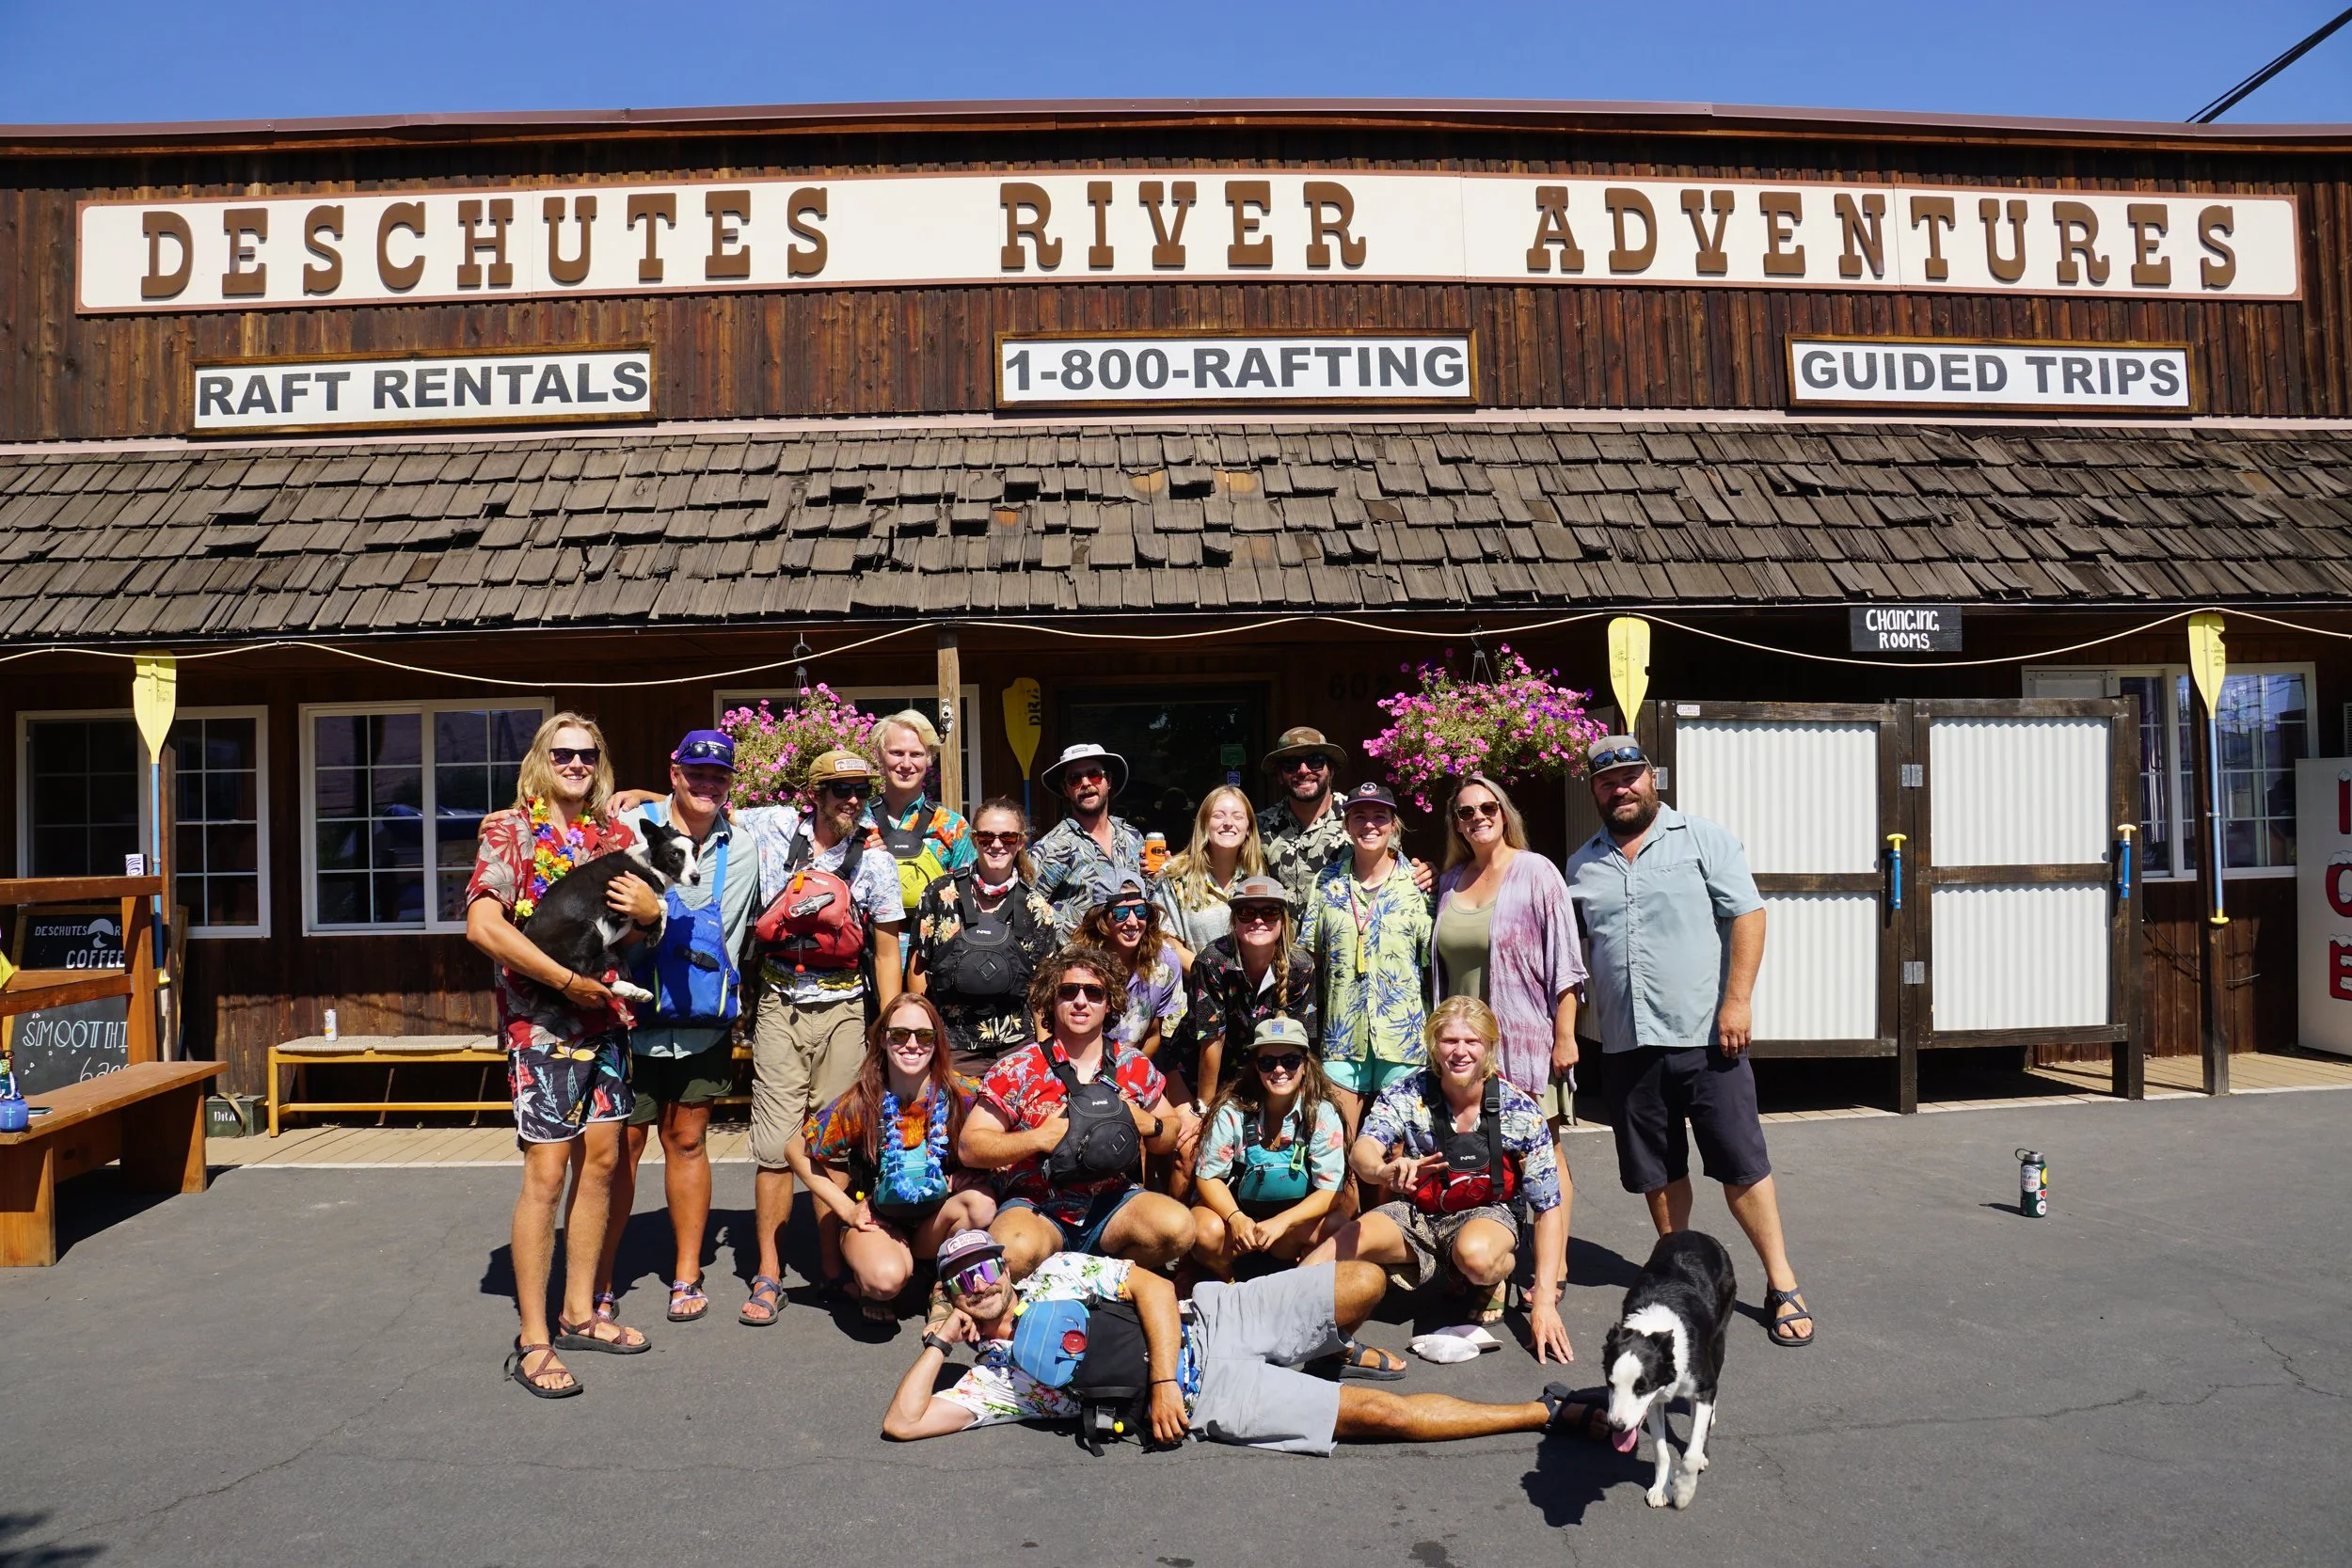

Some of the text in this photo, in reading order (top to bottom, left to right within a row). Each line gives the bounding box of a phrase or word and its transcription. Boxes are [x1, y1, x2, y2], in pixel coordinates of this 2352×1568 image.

[141, 181, 2237, 301] DESCHUTES RIVER ADVENTURES
[1005, 346, 1465, 390] 1-800-RAFTING
[1801, 350, 2181, 397] GUIDED TRIPS
[199, 361, 648, 417] RAFT RENTALS
[1879, 632, 1931, 649] ROOMS
[34, 925, 87, 937] DESCHUTES
[66, 948, 125, 969] COFFEE
[22, 1020, 129, 1049] SMOOTHI
